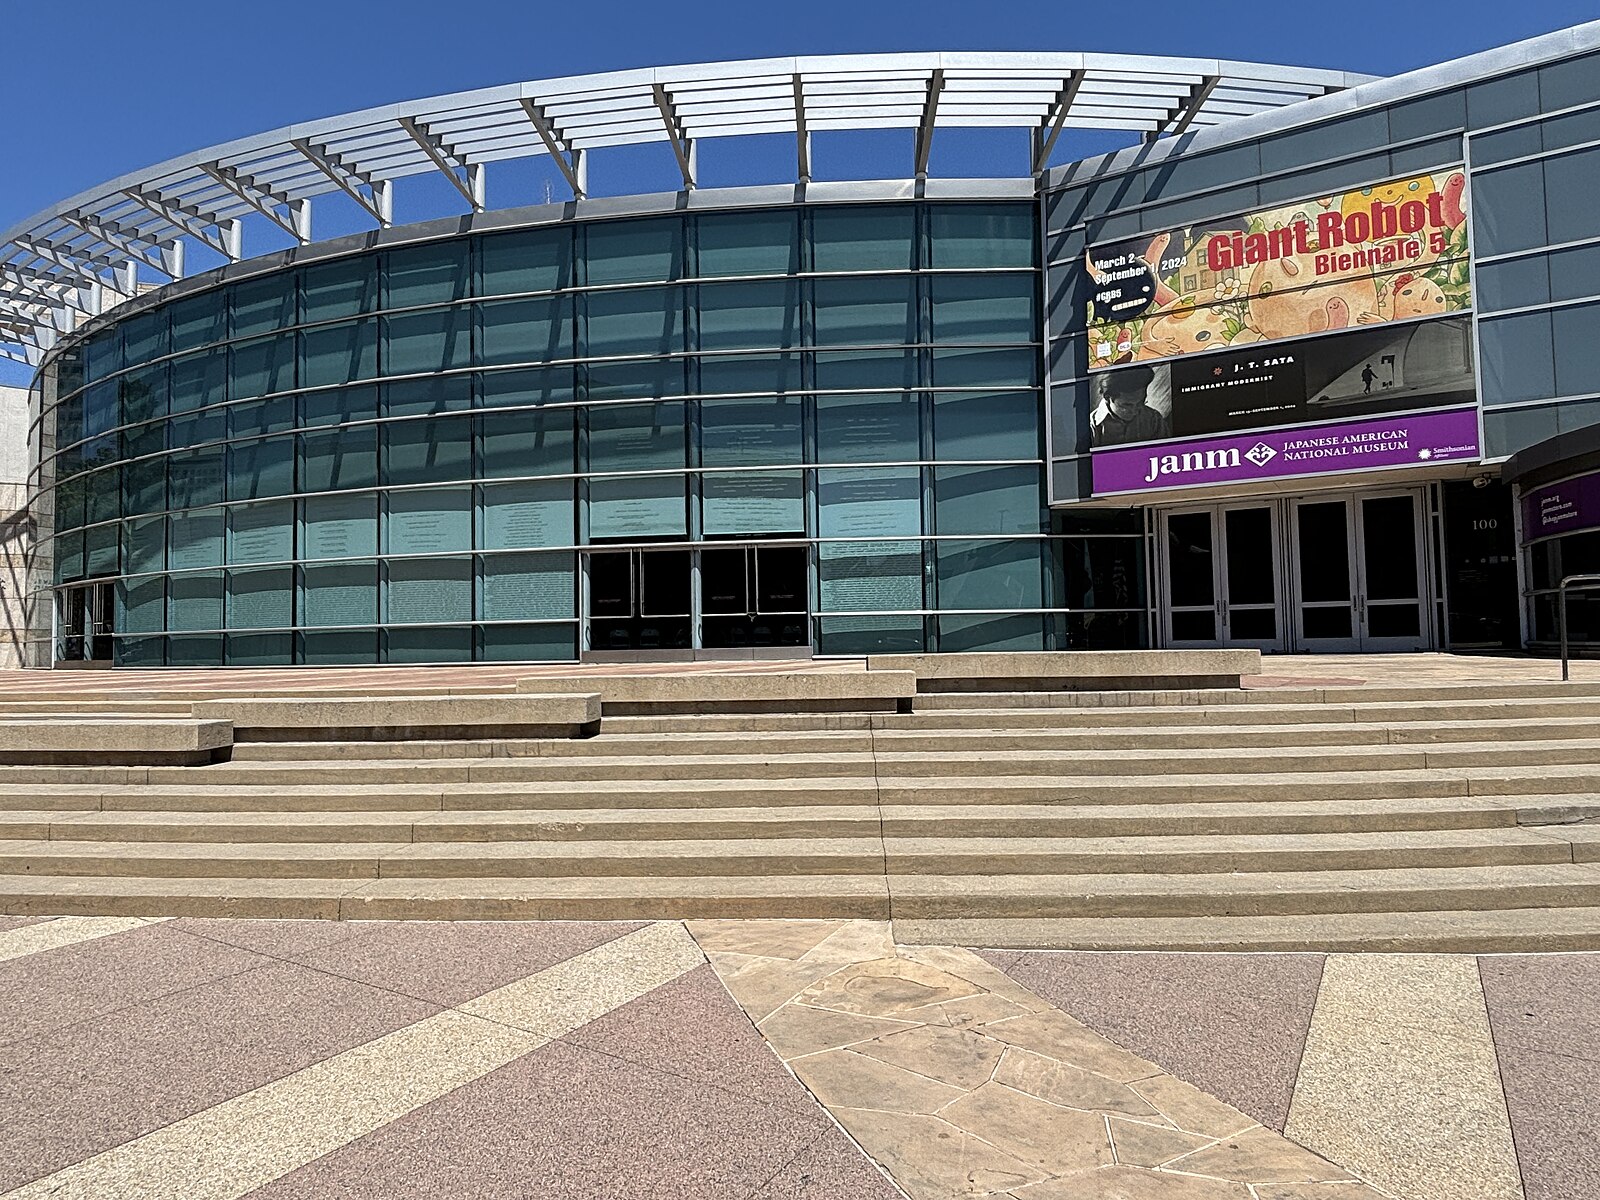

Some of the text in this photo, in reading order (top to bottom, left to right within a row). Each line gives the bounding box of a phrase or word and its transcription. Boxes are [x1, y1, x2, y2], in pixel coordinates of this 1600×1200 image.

[1207, 191, 1445, 272] Giant Robot
[1095, 255, 1126, 271] March
[1128, 253, 1136, 264] 2
[1315, 231, 1446, 276] Biennale 5
[1095, 265, 1147, 286] September
[1161, 256, 1188, 271] 2024
[1234, 356, 1294, 373] J. T. SATA
[1181, 375, 1274, 393] IMMIGRANT MODERNIST
[1283, 429, 1408, 452] JAPANESE AMERICAN
[1433, 444, 1476, 454] Smithsonian
[1284, 441, 1409, 461] NATIONAL MUSEUM
[1144, 447, 1241, 482] janm
[1472, 519, 1498, 530] 100
